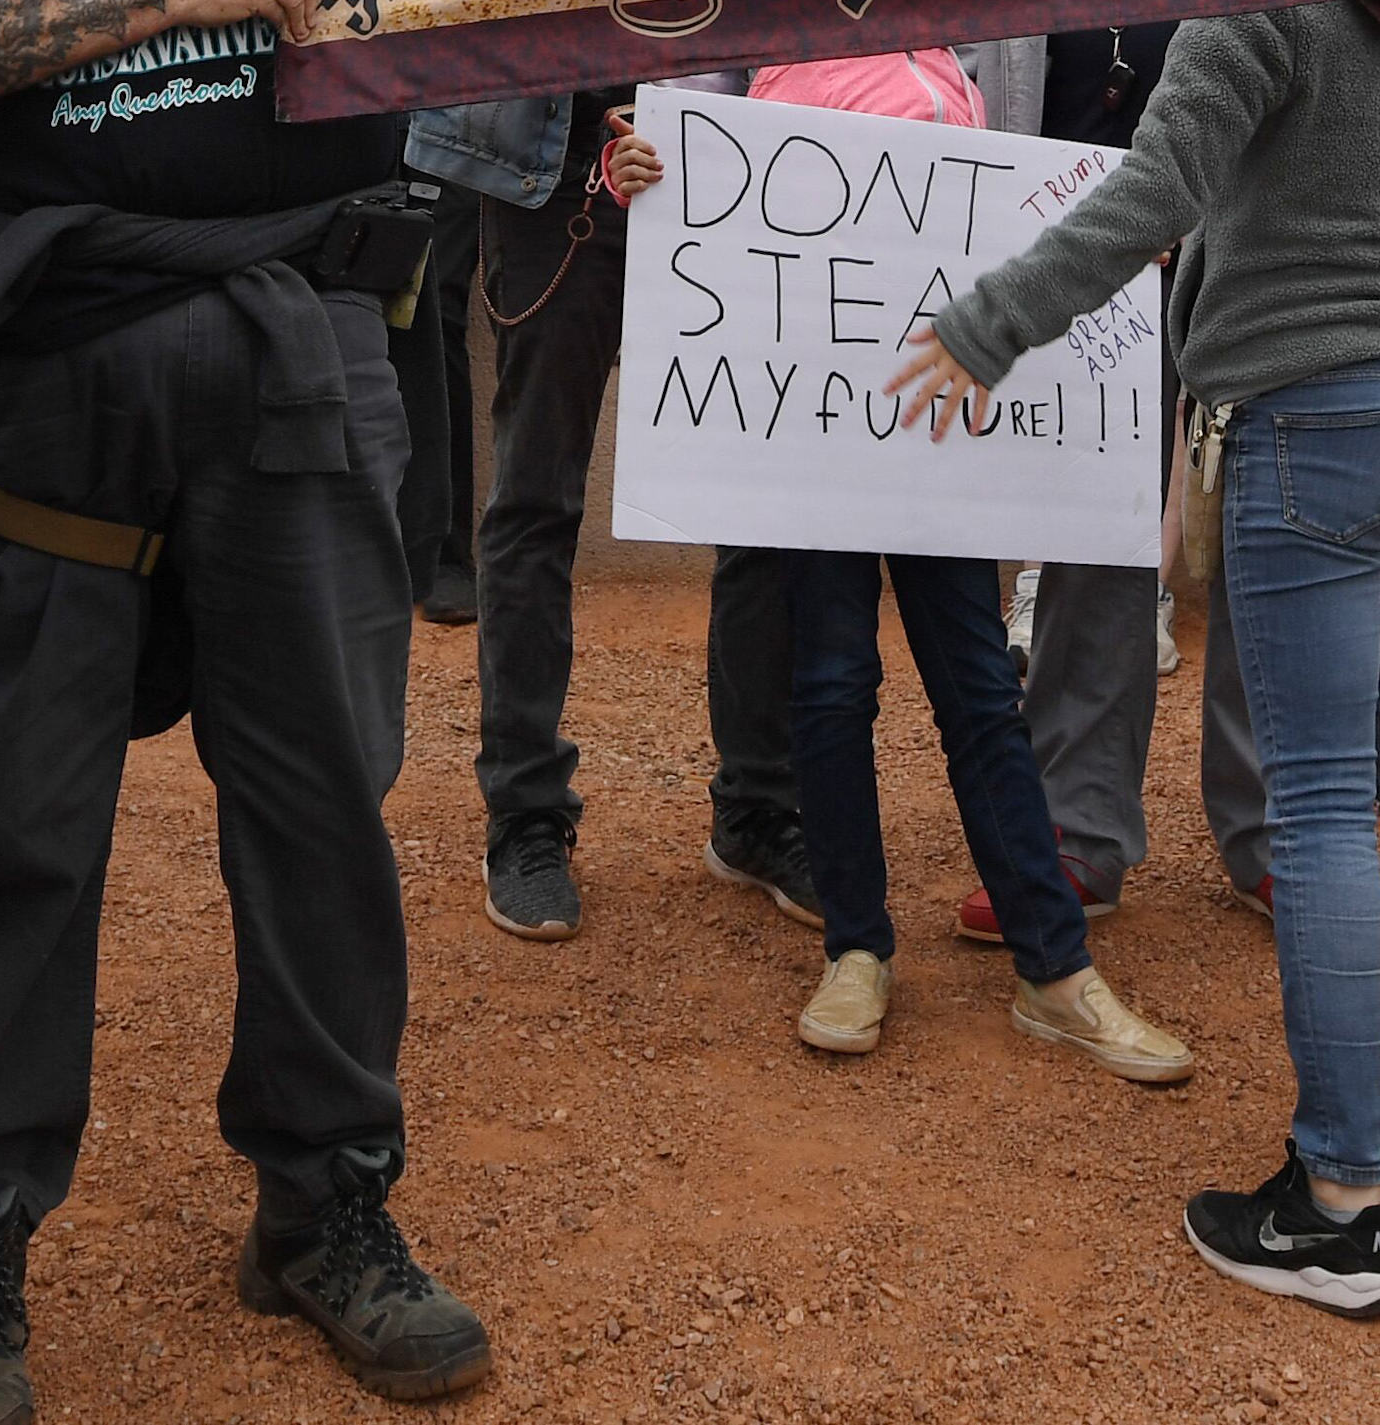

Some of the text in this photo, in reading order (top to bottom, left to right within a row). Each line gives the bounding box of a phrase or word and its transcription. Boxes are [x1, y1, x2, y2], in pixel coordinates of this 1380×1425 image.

[51, 64, 257, 133] Any Questions?
[681, 109, 1015, 257] DONT
[671, 241, 955, 352] STEA
